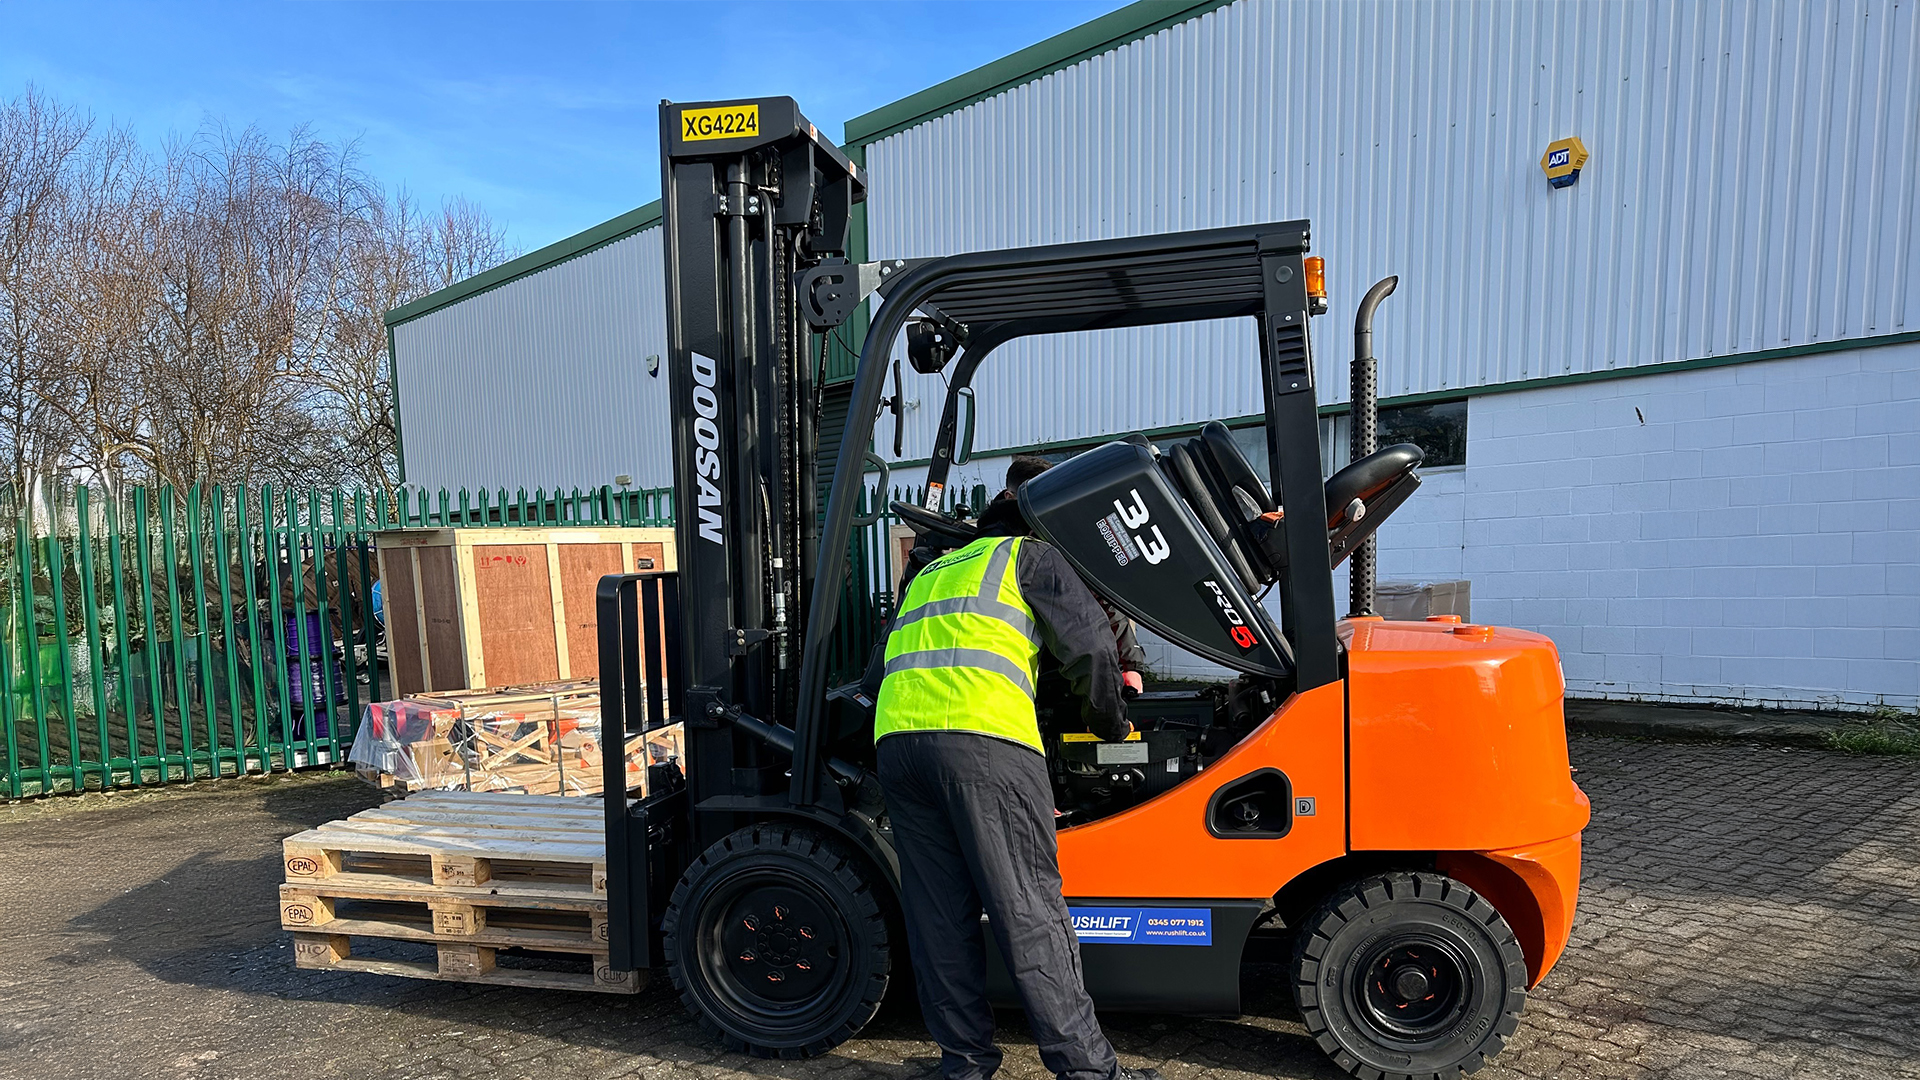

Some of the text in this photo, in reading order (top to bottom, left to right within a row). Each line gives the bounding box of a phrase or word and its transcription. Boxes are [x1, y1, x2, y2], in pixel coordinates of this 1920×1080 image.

[684, 111, 756, 137] XG4224
[1549, 151, 1569, 166] ADT
[691, 350, 723, 546] DOOSAN
[1113, 487, 1171, 565] 33
[1095, 518, 1129, 567] EQUIPPED
[292, 860, 314, 872] EPAL
[288, 908, 310, 920] EPAL
[1071, 916, 1132, 929] USHLIFT
[1148, 918, 1169, 926] 0345
[1187, 919, 1204, 927] 1912
[1145, 929, 1207, 937] www.rushlift.co.uk
